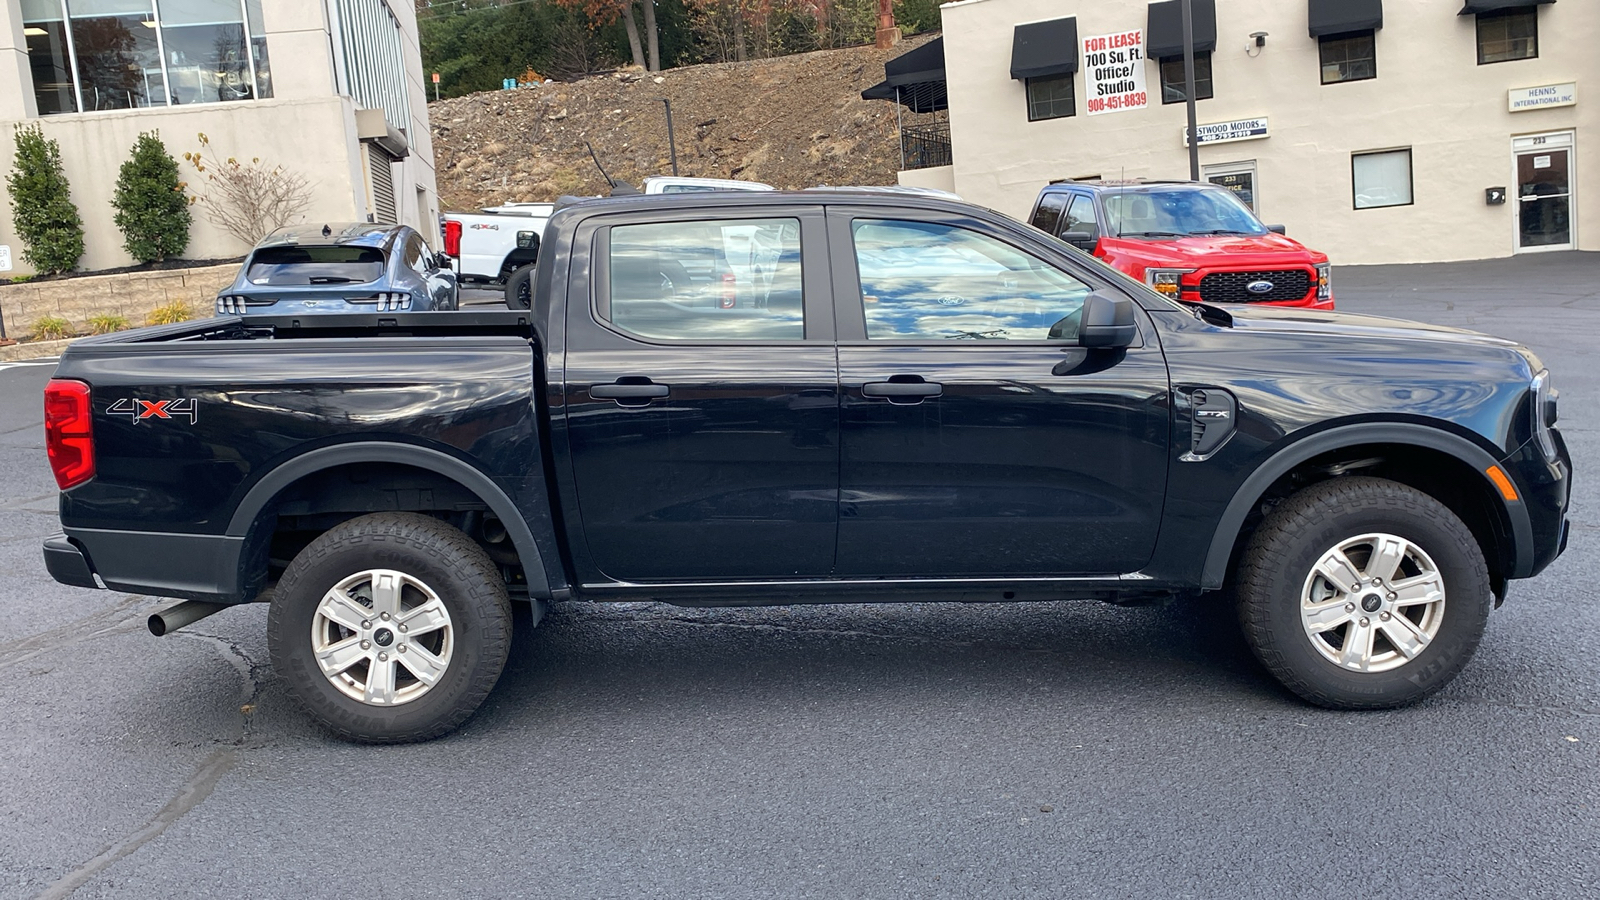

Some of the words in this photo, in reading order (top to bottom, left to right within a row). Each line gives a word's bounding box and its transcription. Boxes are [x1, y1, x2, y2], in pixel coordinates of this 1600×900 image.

[1085, 38, 1106, 53] FOR
[1109, 31, 1142, 49] LEASE
[1085, 52, 1106, 67] 700
[1109, 50, 1127, 64] Sq.
[1129, 47, 1143, 61] Ft.
[1095, 63, 1135, 81] Office/
[1097, 80, 1135, 96] Studio
[1528, 87, 1557, 97] HENNIS
[1087, 91, 1147, 113] 908-451-8839
[1514, 96, 1560, 107] INTERNATIONAL
[1561, 94, 1572, 102] INC
[1187, 124, 1228, 136] STWOOD
[1230, 120, 1260, 131] MOTORS
[1532, 137, 1547, 145] 233
